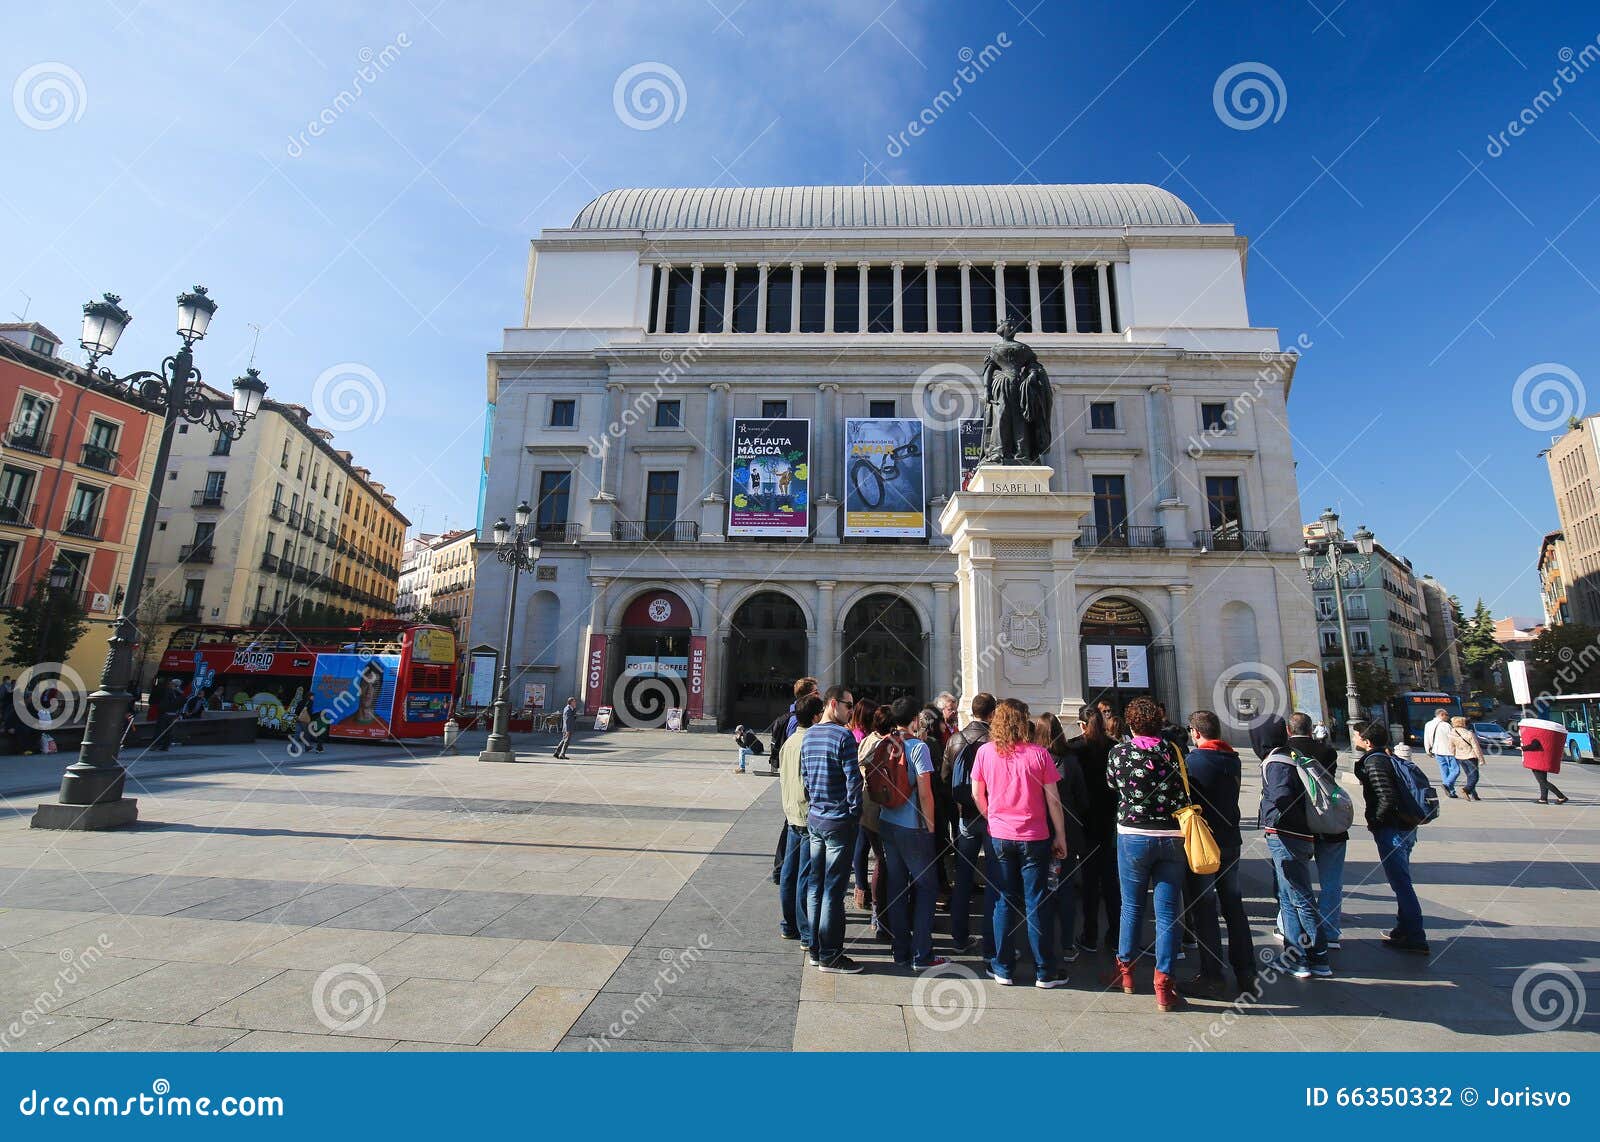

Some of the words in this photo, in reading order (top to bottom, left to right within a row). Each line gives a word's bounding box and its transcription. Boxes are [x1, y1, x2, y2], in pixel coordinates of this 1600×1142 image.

[738, 438, 751, 446] LA
[754, 437, 792, 446] FLAUTA
[737, 445, 781, 455] MÁGICA
[992, 483, 1027, 492] ISABEL
[233, 651, 274, 667] MADRID
[590, 650, 602, 689] COSTA
[659, 663, 688, 671] COFFEE
[692, 649, 703, 694] COFFEE
